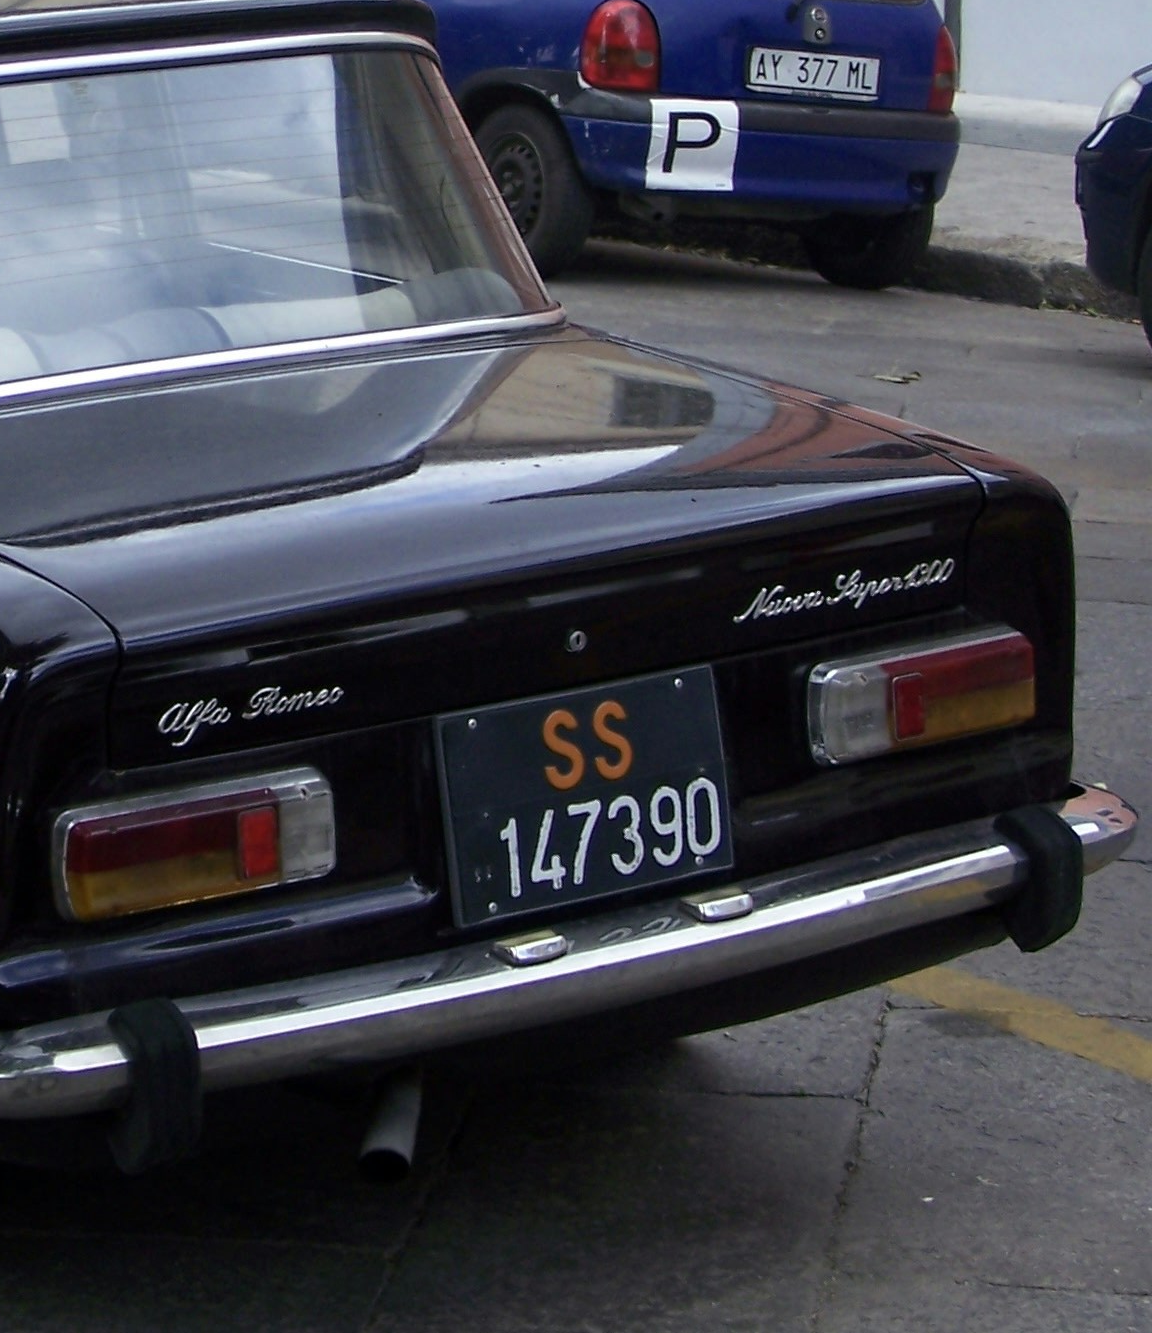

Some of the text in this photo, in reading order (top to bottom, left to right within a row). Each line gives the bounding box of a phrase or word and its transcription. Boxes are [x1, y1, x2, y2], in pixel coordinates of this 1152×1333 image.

[756, 53, 873, 90] AY 377 ML
[662, 112, 721, 173] P
[733, 585, 824, 623] Nuova
[826, 569, 903, 610] Super
[158, 686, 344, 747] Alfa Romeo
[542, 700, 634, 791] SS
[499, 776, 721, 898] 147390
